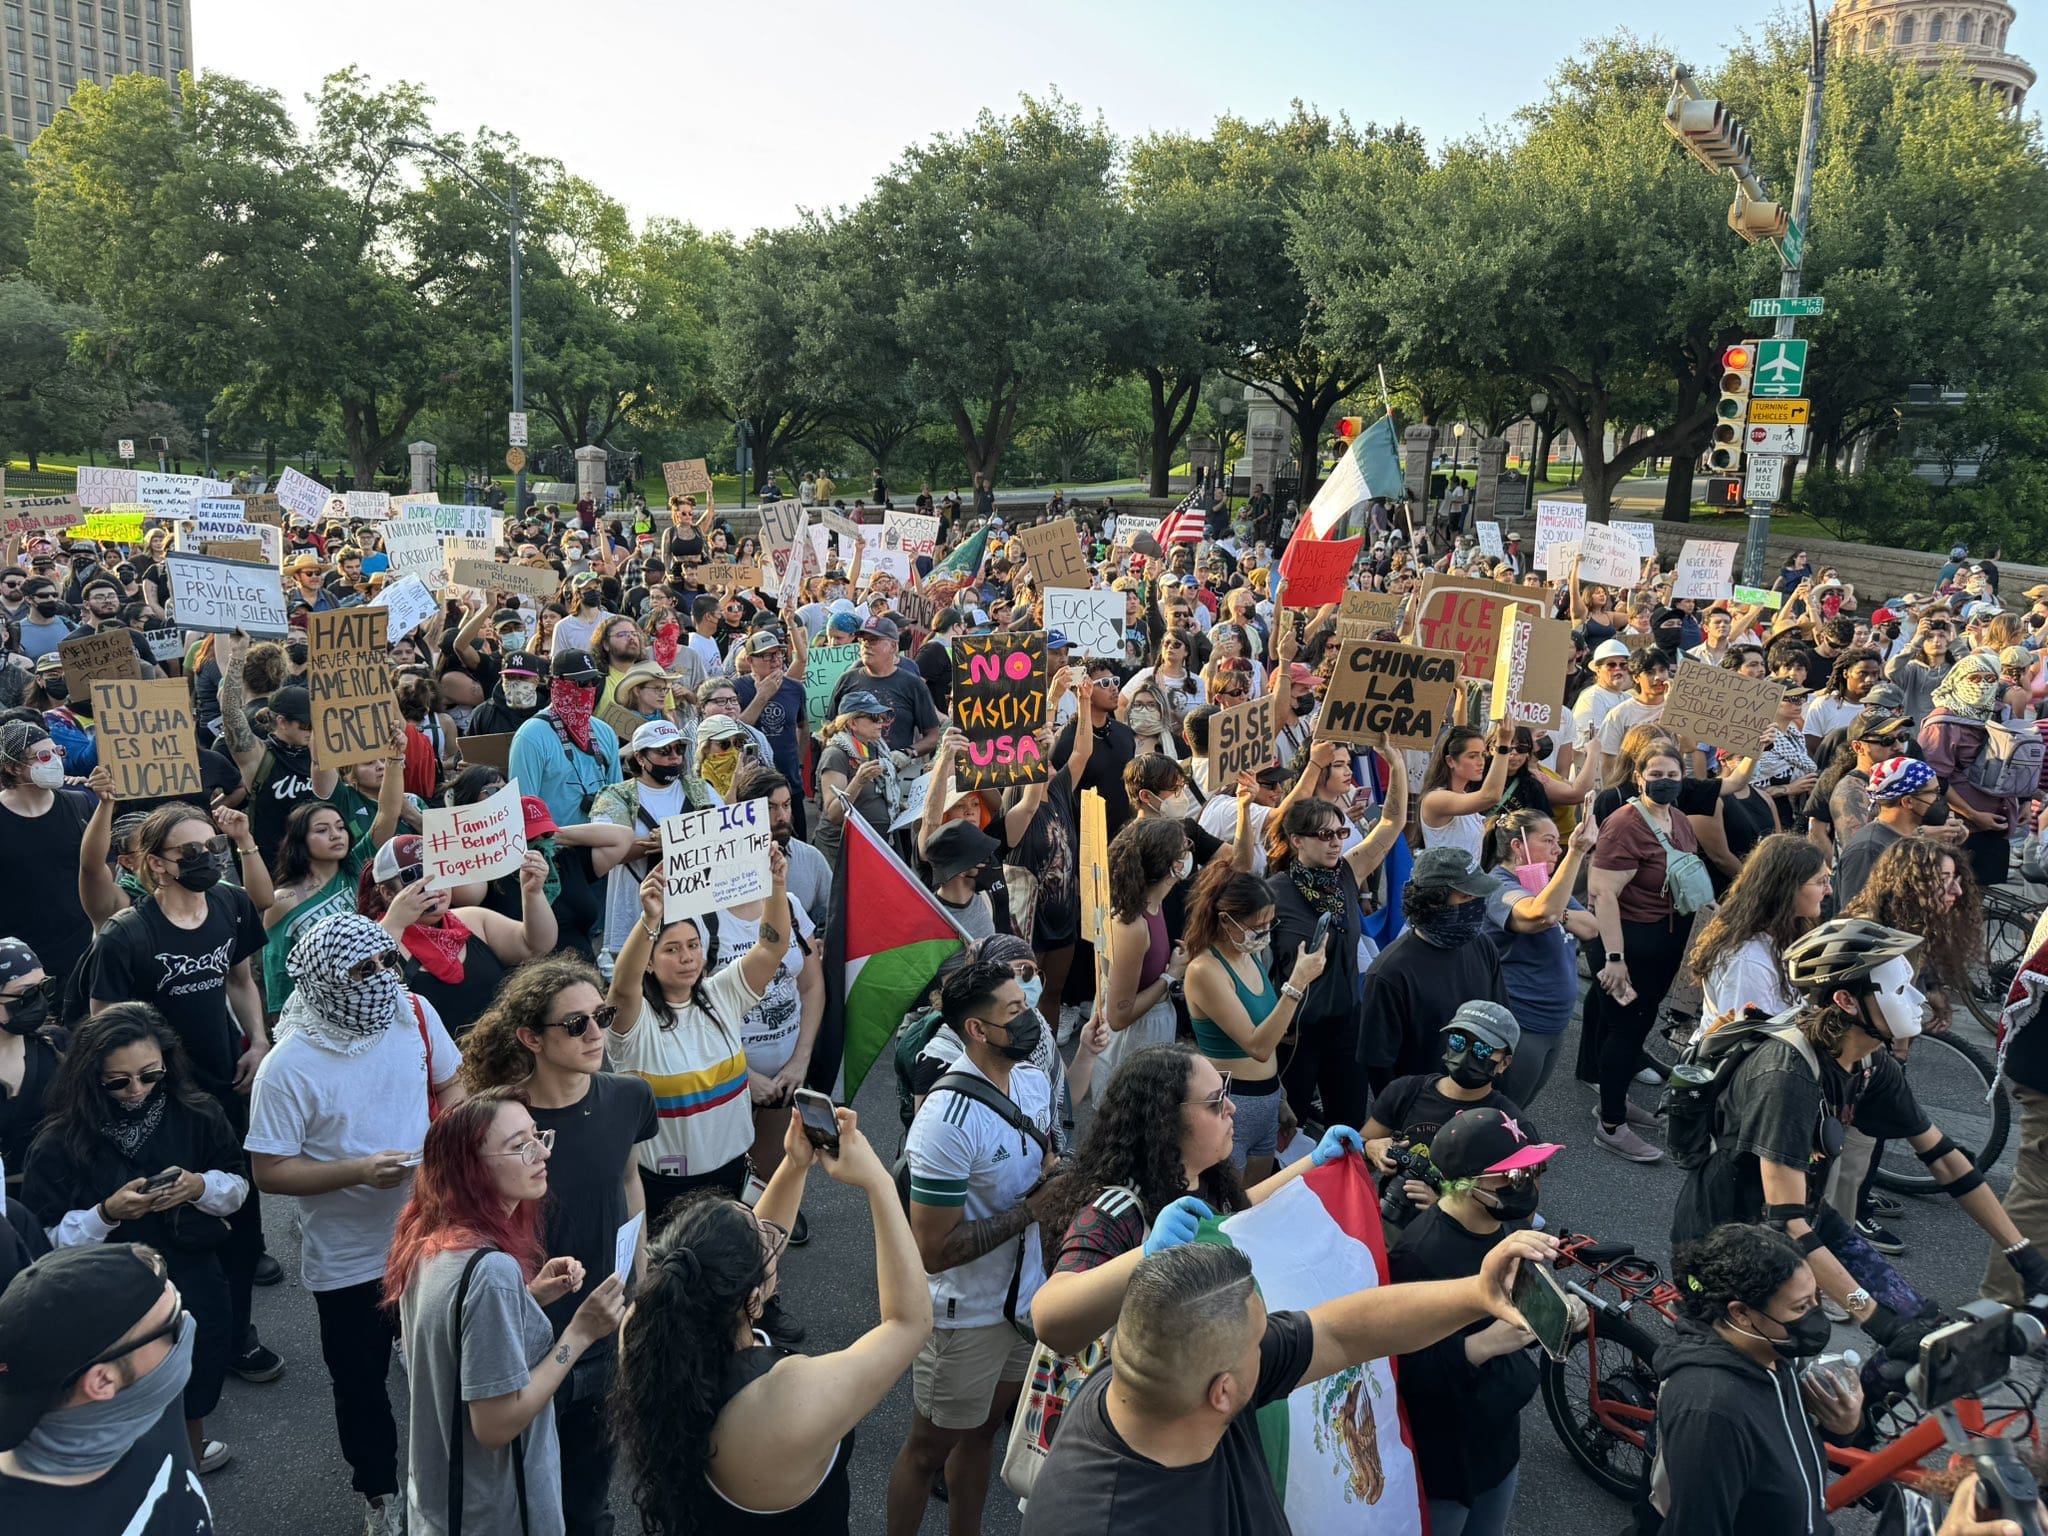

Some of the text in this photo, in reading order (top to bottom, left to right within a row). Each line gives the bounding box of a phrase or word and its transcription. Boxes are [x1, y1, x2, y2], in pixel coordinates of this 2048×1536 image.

[1752, 300, 1781, 315] 11th
[1806, 306, 1820, 314] 100
[1755, 403, 1789, 411] TURNING
[79, 469, 108, 486] FUCK
[19, 497, 71, 509] ILLEGAL
[1727, 483, 1740, 501] 14
[1747, 490, 1775, 498] SIGNAL
[216, 503, 241, 511] FUERA
[434, 507, 465, 529] ONE
[468, 508, 487, 530] IS
[1540, 505, 1585, 518] THEY BLAME
[198, 522, 257, 535] MAYDAY!
[889, 513, 937, 531] WORST
[1118, 517, 1128, 526] NO
[1145, 519, 1158, 528] WAY
[1538, 515, 1584, 530] IMMIGRANTS
[1589, 527, 1598, 537] I
[902, 538, 936, 554] EVER
[1542, 529, 1573, 543] SO YOU
[390, 546, 440, 570] CORRUPT
[1296, 543, 1332, 575] MAKE
[1696, 542, 1725, 558] HATE
[175, 563, 239, 584] IT'S A
[708, 565, 753, 580] FUCK ICE
[1028, 542, 1082, 585] ICE
[1686, 558, 1706, 567] NEVER
[1691, 568, 1719, 580] AMERICA
[186, 580, 267, 604] PRIVILEGE
[1686, 582, 1720, 598] GREAT
[177, 597, 287, 625] TO STAY SILENT
[1049, 594, 1108, 622] FUCK
[1441, 593, 1496, 630] ICE
[315, 611, 387, 650] HATE
[1051, 618, 1125, 654] ICE!
[69, 657, 93, 672] THE
[312, 649, 389, 670] NEVER MADE
[970, 650, 1033, 684] NO
[1349, 646, 1456, 683] CHINGA
[310, 665, 392, 702] AMERICA
[1365, 675, 1415, 704] LA
[1678, 661, 1779, 702] DEPORTING
[94, 684, 138, 710] TU
[1675, 679, 1765, 713] PEOPLE ON
[100, 708, 188, 735] LUCHA
[764, 706, 782, 718] 90
[957, 690, 1045, 731] FASCIST
[1325, 700, 1433, 738] MIGRA
[1663, 713, 1689, 728] IS
[1673, 694, 1772, 731] STOLEN LAND
[322, 700, 393, 754] GREAT
[1219, 701, 1271, 749] SI SE
[113, 734, 183, 760] ES MI
[969, 734, 1041, 767] USA
[1219, 732, 1272, 783] PUEDE
[104, 762, 202, 798] LUCHA
[450, 805, 510, 836] Families
[528, 803, 543, 819] A
[667, 800, 756, 845] LET ICE
[461, 828, 508, 850] Belong
[432, 843, 513, 877] Together
[669, 833, 769, 876] MELT AT THE
[667, 866, 711, 897] DOOR!
[748, 1029, 786, 1044] PUSHES
